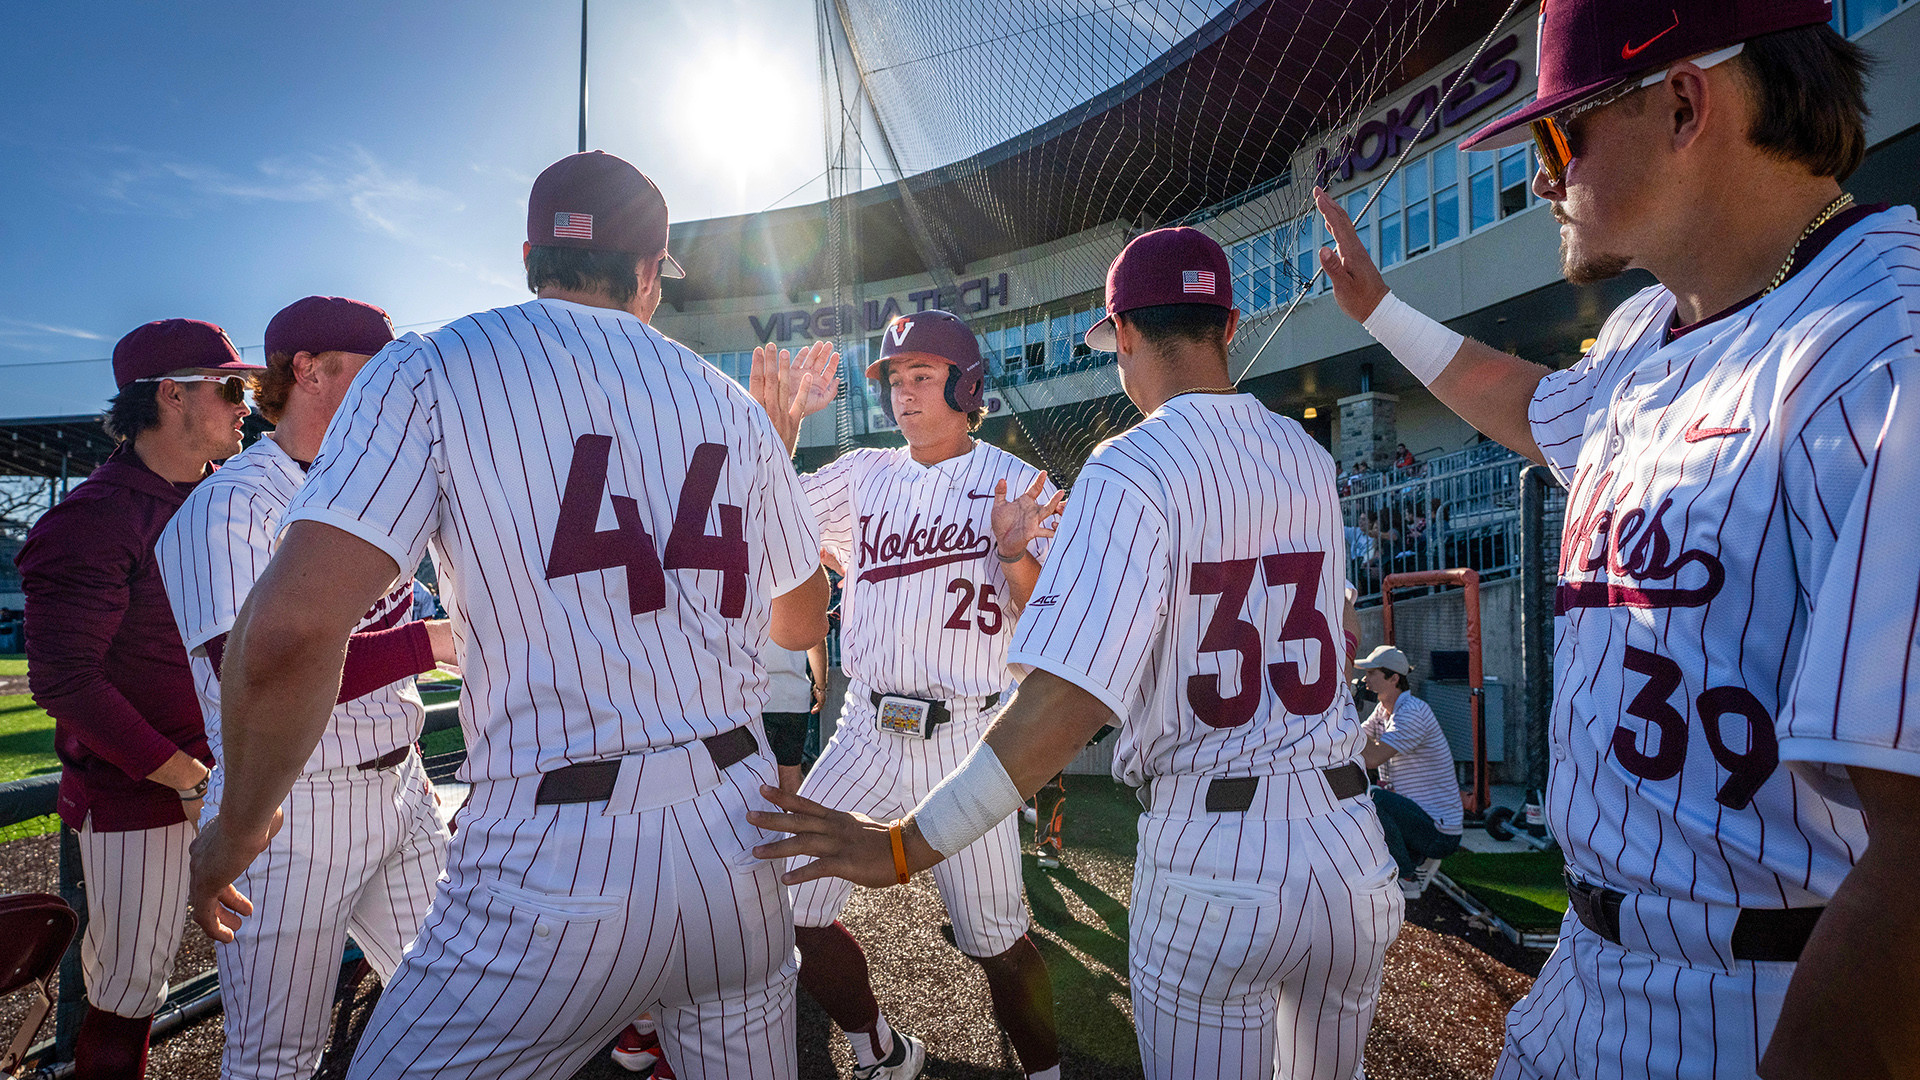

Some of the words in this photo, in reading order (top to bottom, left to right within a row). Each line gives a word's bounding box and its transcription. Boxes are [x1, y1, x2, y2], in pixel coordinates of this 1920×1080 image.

[1315, 34, 1521, 189] HOKIES
[748, 297, 904, 343] VIRGINIA
[908, 273, 1008, 314] TECH
[545, 433, 750, 618] 44
[857, 511, 991, 569] Hokies
[943, 578, 1002, 635] 25
[1030, 595, 1060, 606] ACC
[1187, 551, 1338, 729] 33
[1613, 644, 1780, 811] 39
